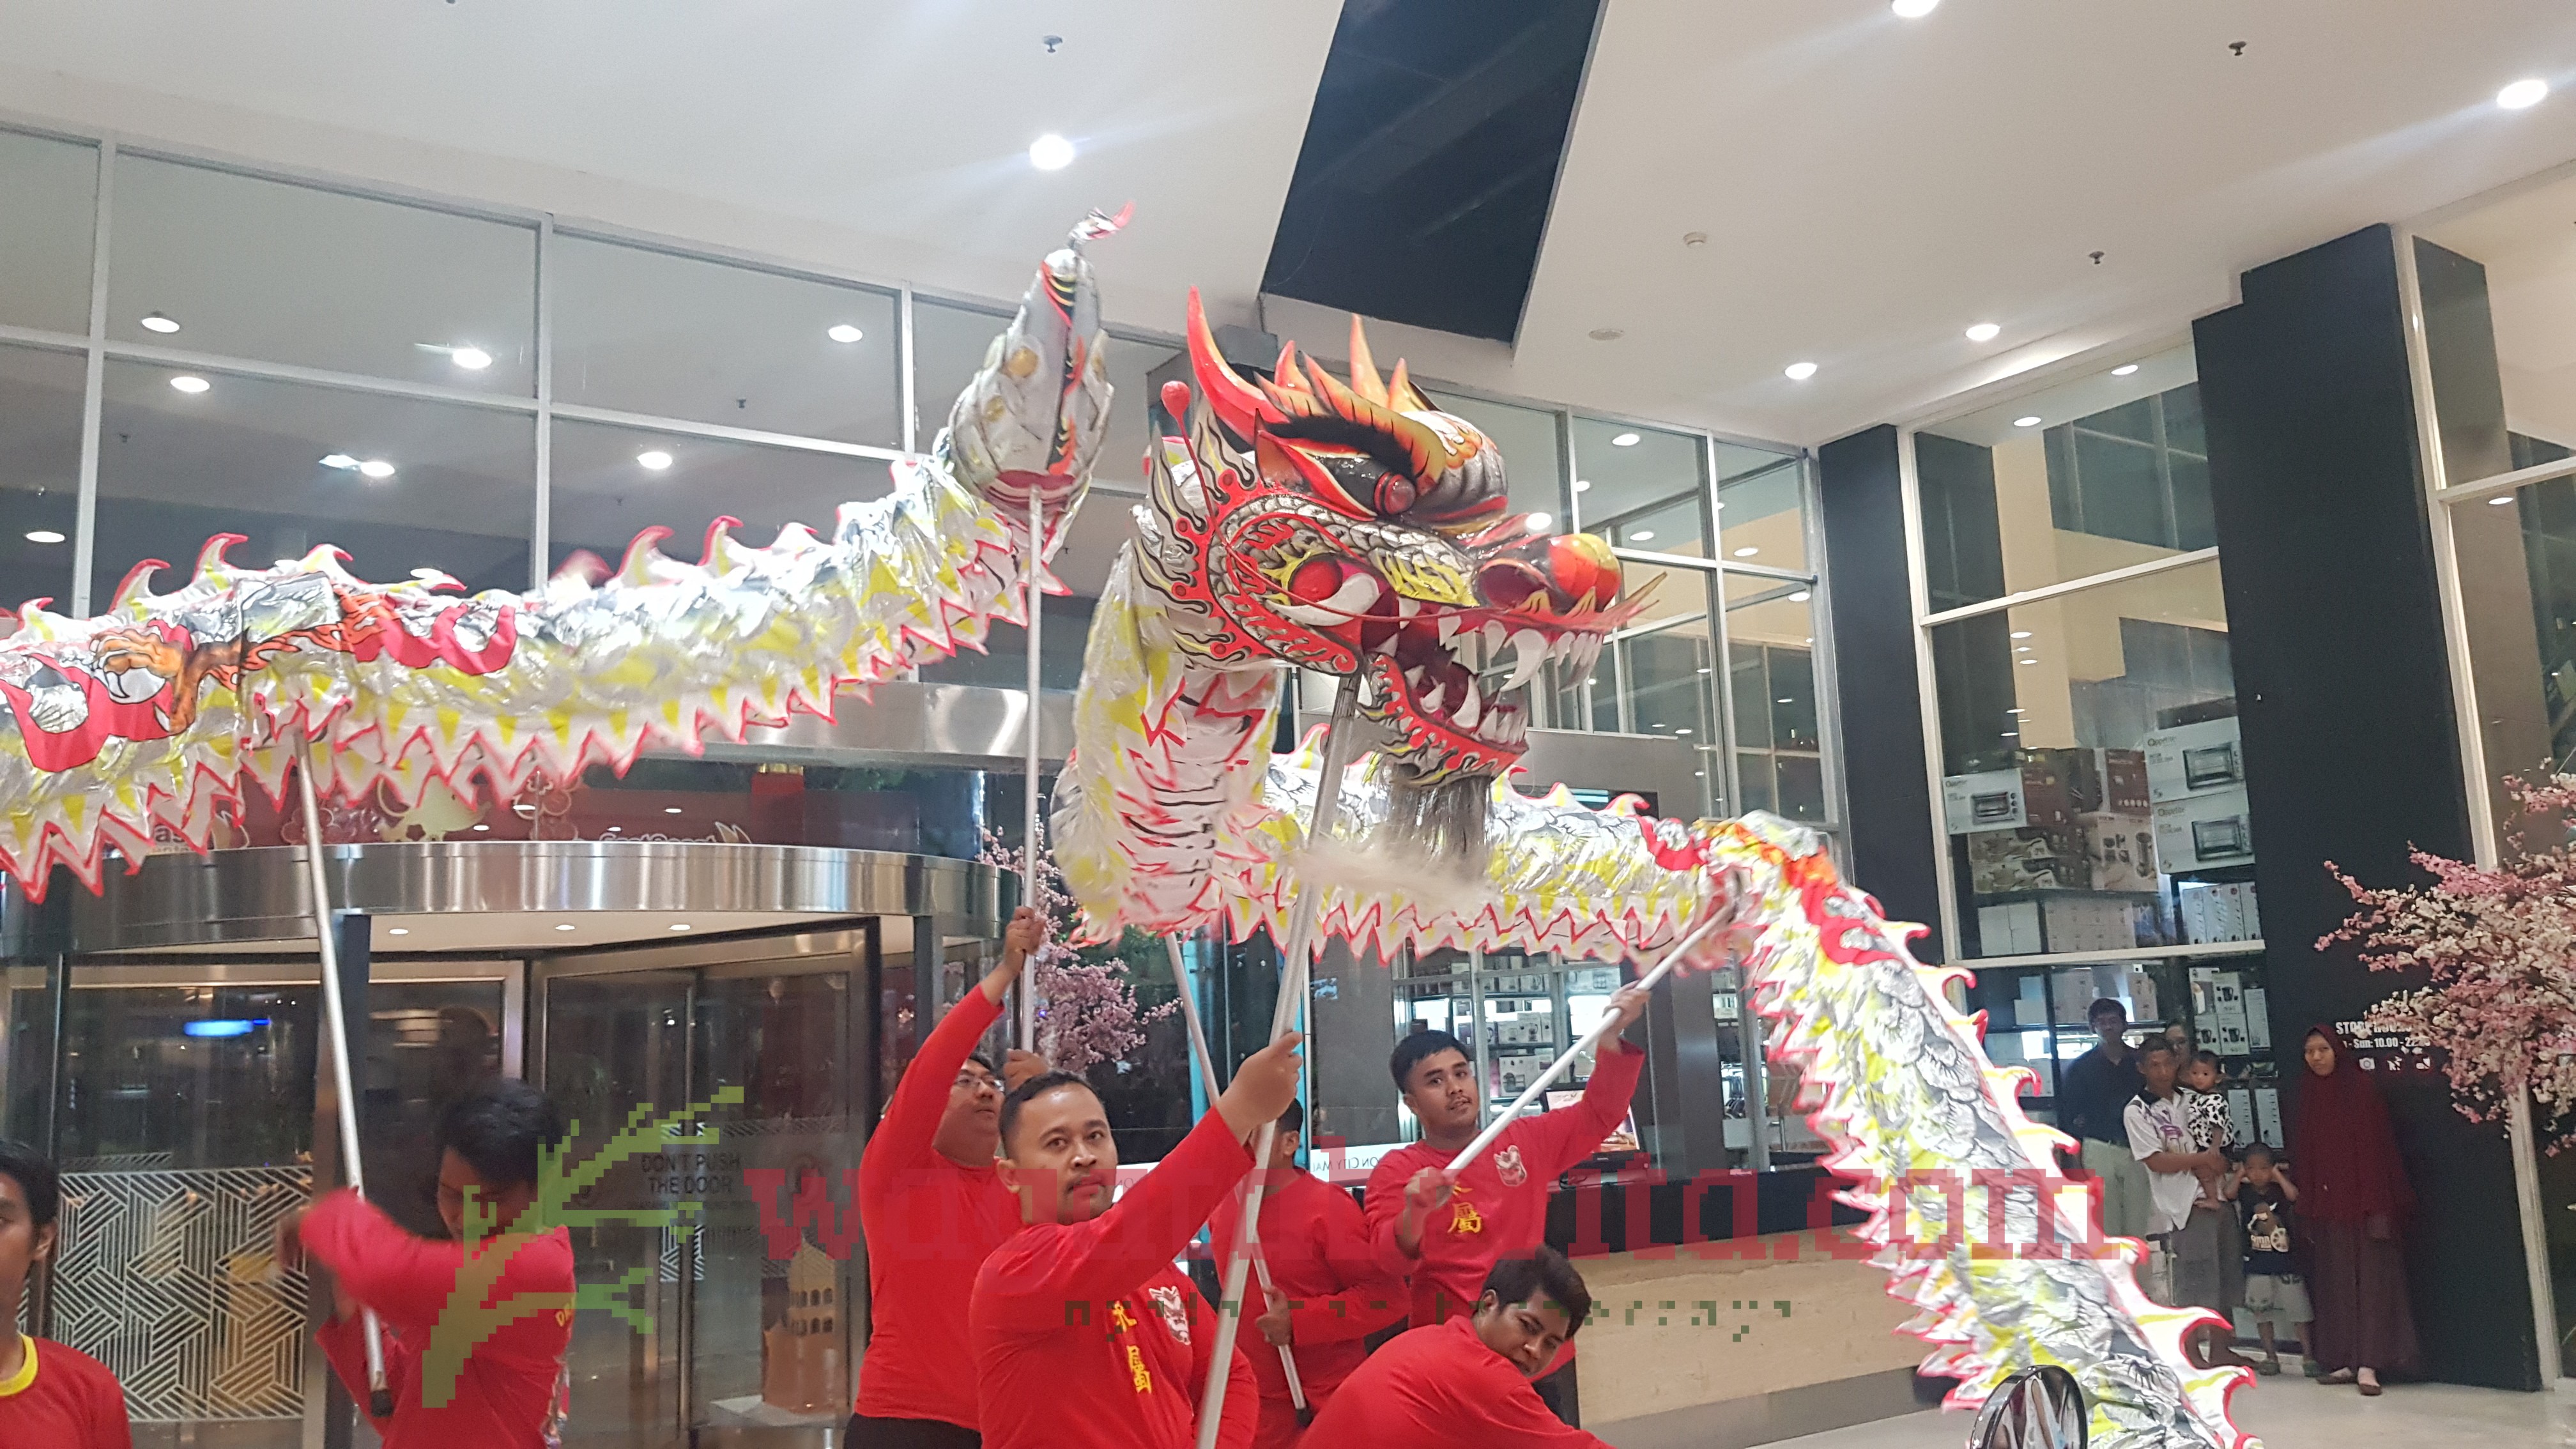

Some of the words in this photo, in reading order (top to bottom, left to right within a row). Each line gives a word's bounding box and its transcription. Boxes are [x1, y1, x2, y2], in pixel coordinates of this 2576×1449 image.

[2354, 1038, 2373, 1048] Sun:
[2374, 1038, 2398, 1048] 10.00
[648, 1176, 679, 1194] THE
